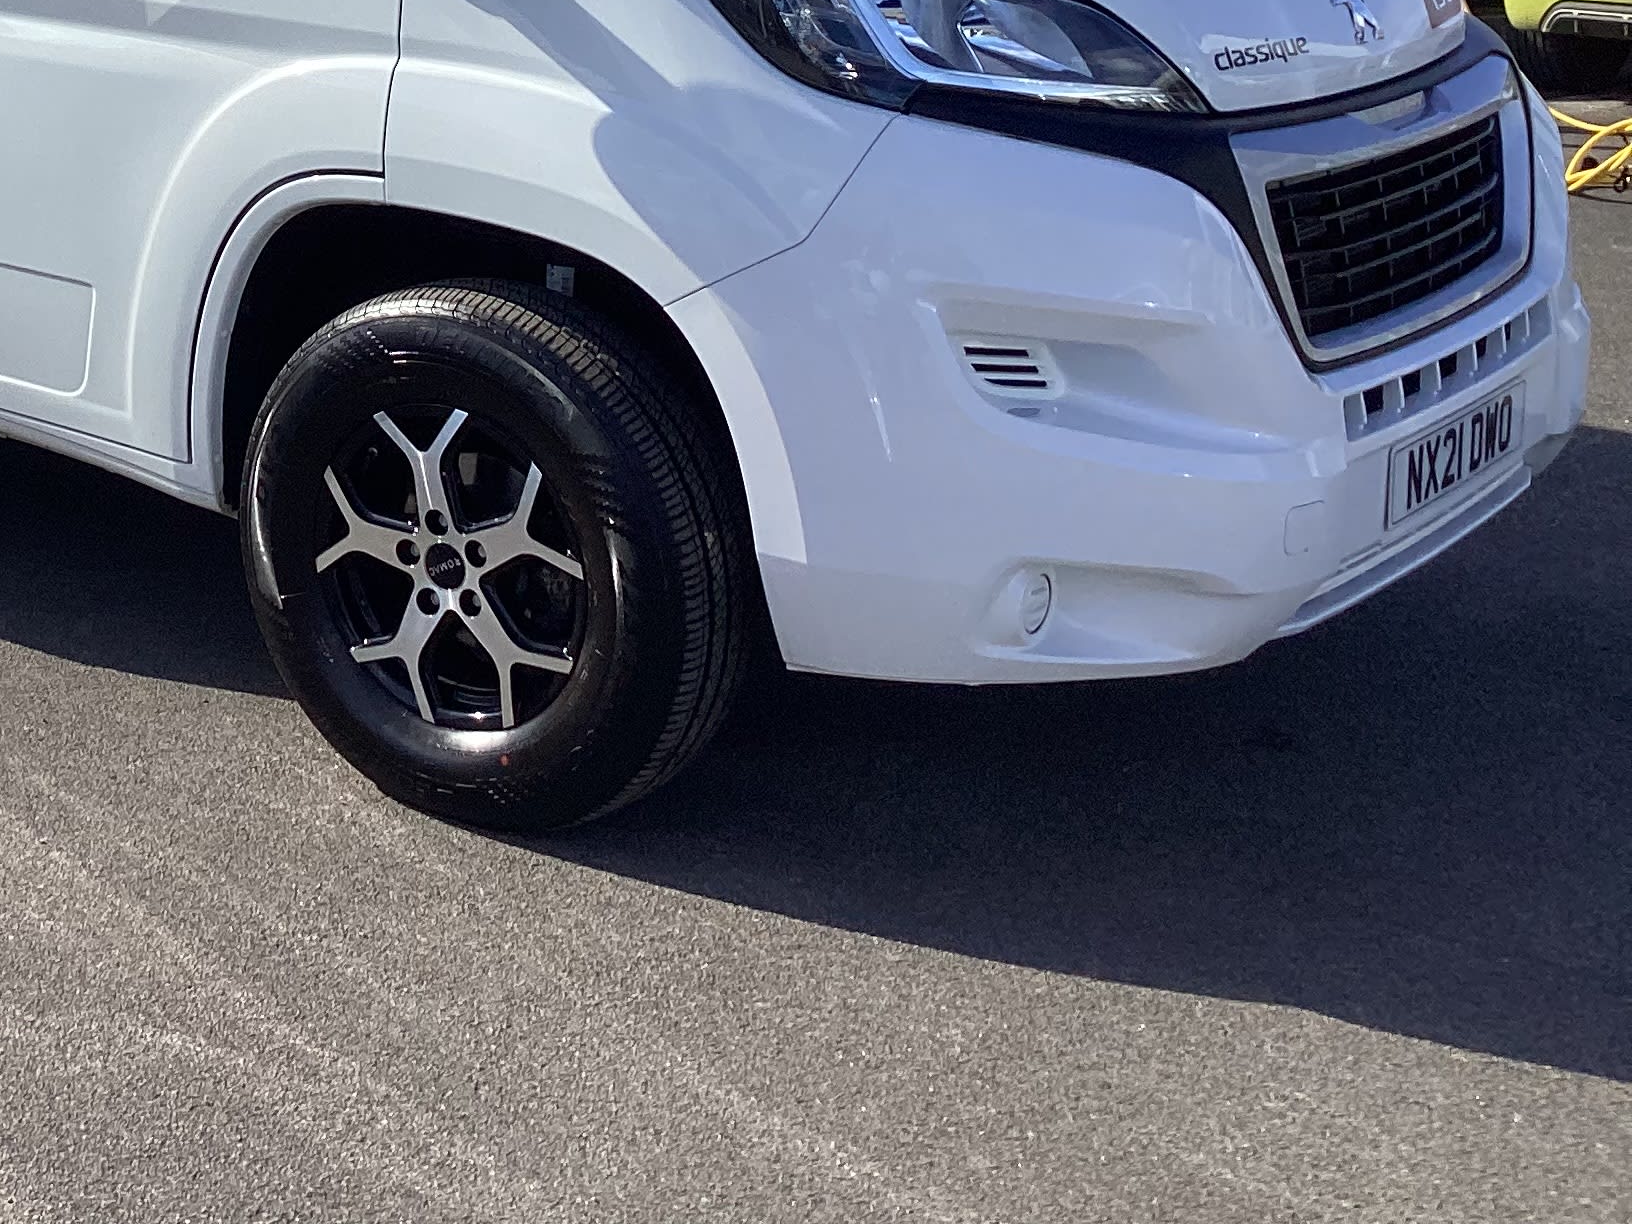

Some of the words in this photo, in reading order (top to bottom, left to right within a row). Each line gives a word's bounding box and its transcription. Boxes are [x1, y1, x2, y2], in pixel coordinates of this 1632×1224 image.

[1214, 37, 1310, 71] classique
[1407, 422, 1464, 510] NX21
[1470, 395, 1512, 472] DWO
